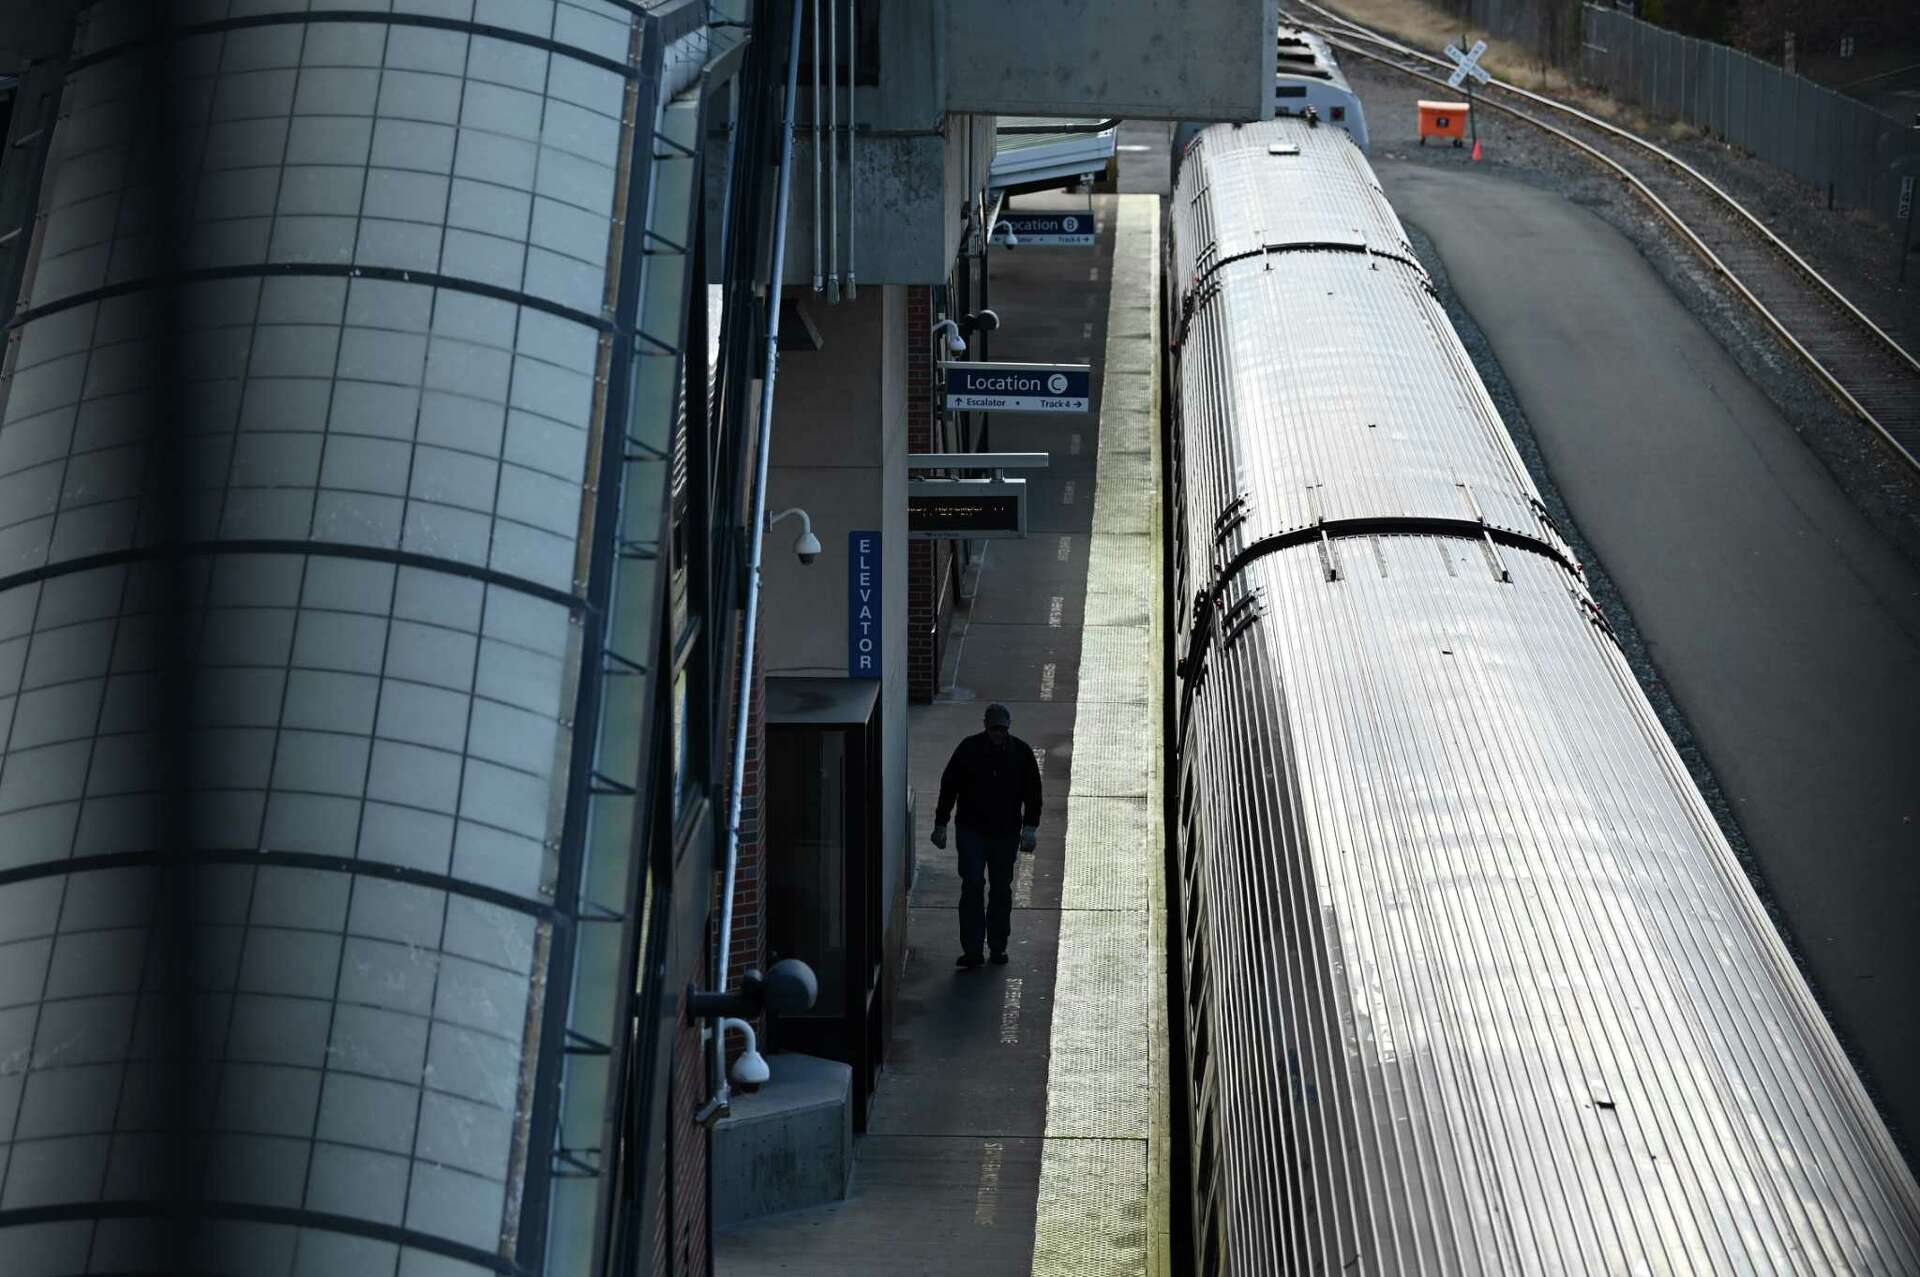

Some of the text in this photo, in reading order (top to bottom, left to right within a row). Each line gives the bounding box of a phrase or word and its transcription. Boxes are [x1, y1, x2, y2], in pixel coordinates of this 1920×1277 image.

[967, 374, 1041, 391] Location
[966, 398, 1070, 408] Escalator Track 4
[859, 539, 873, 669] ELEVATOR
